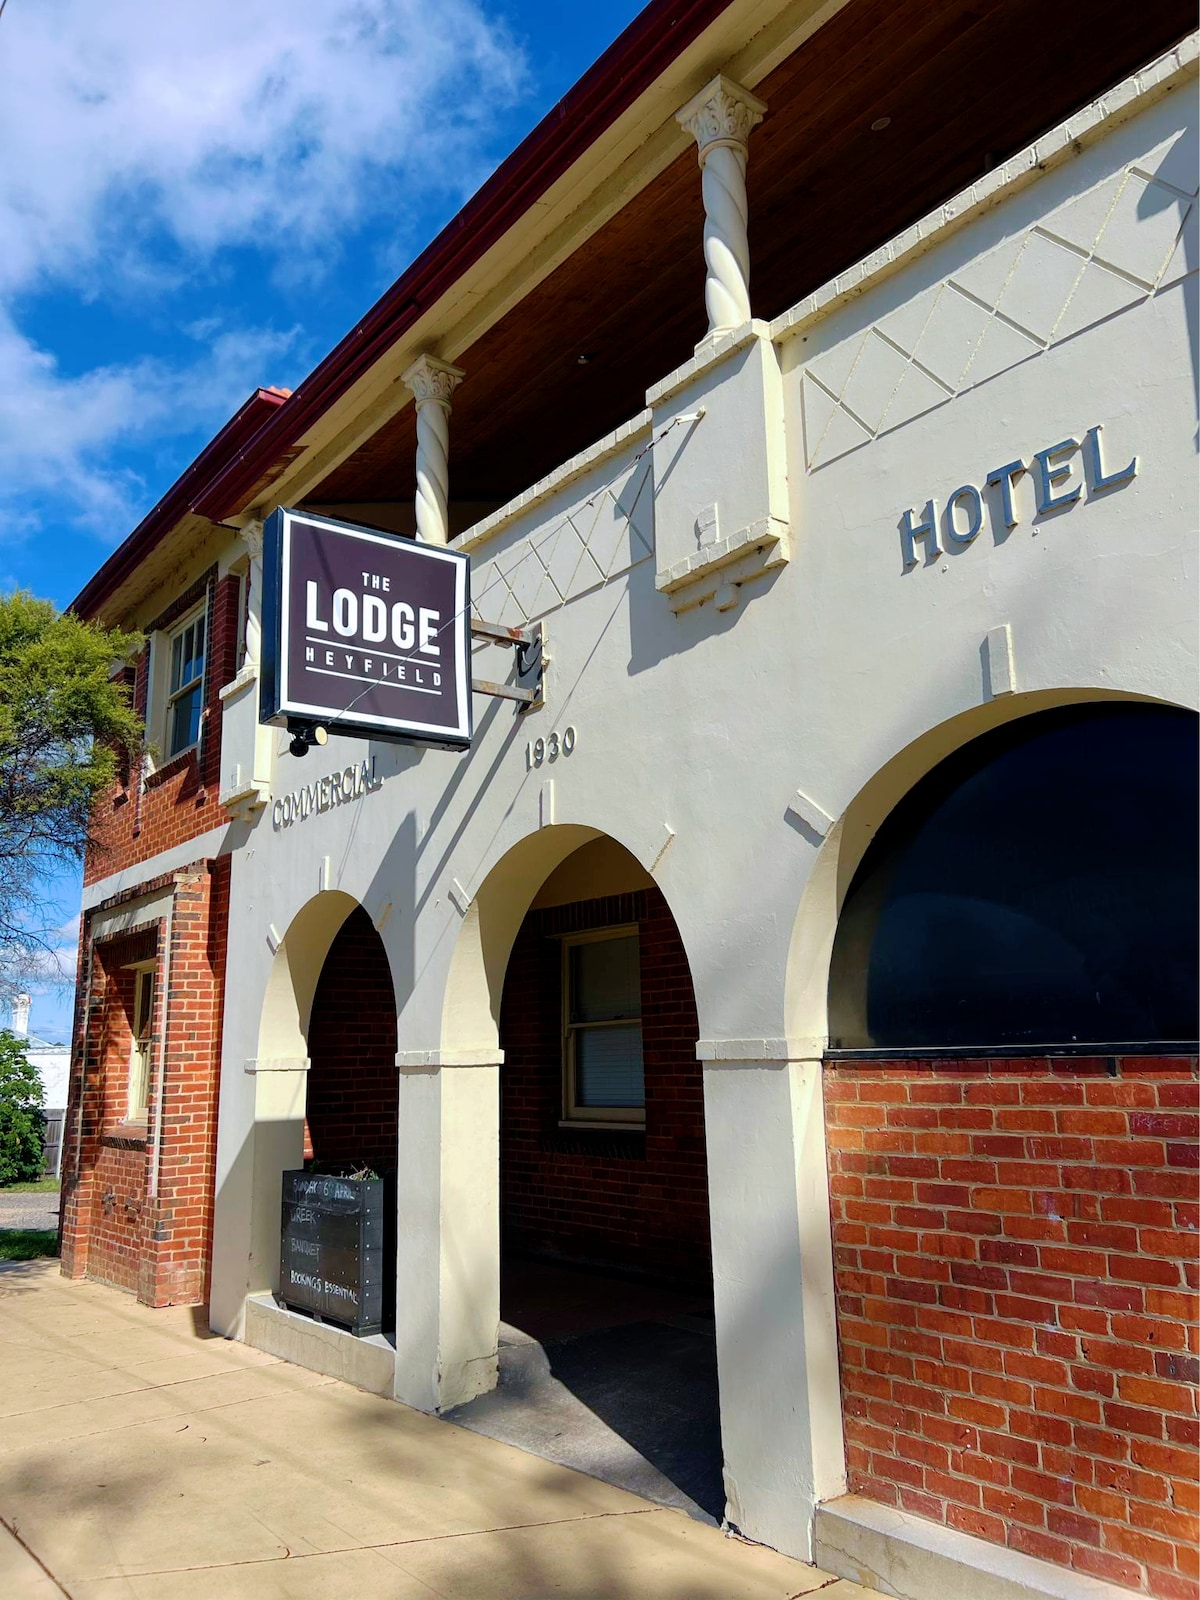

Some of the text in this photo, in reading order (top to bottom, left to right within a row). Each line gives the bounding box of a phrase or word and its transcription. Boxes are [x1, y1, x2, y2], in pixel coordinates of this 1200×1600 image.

[902, 424, 1140, 566] HOTEL
[362, 571, 391, 592] THE
[306, 580, 440, 656] LODGE
[306, 646, 442, 686] HEYFIELD
[527, 725, 577, 769] 1930
[272, 755, 385, 829] COMMERCIAL
[290, 1270, 359, 1306] BOOKINGS ESSENTIAL
